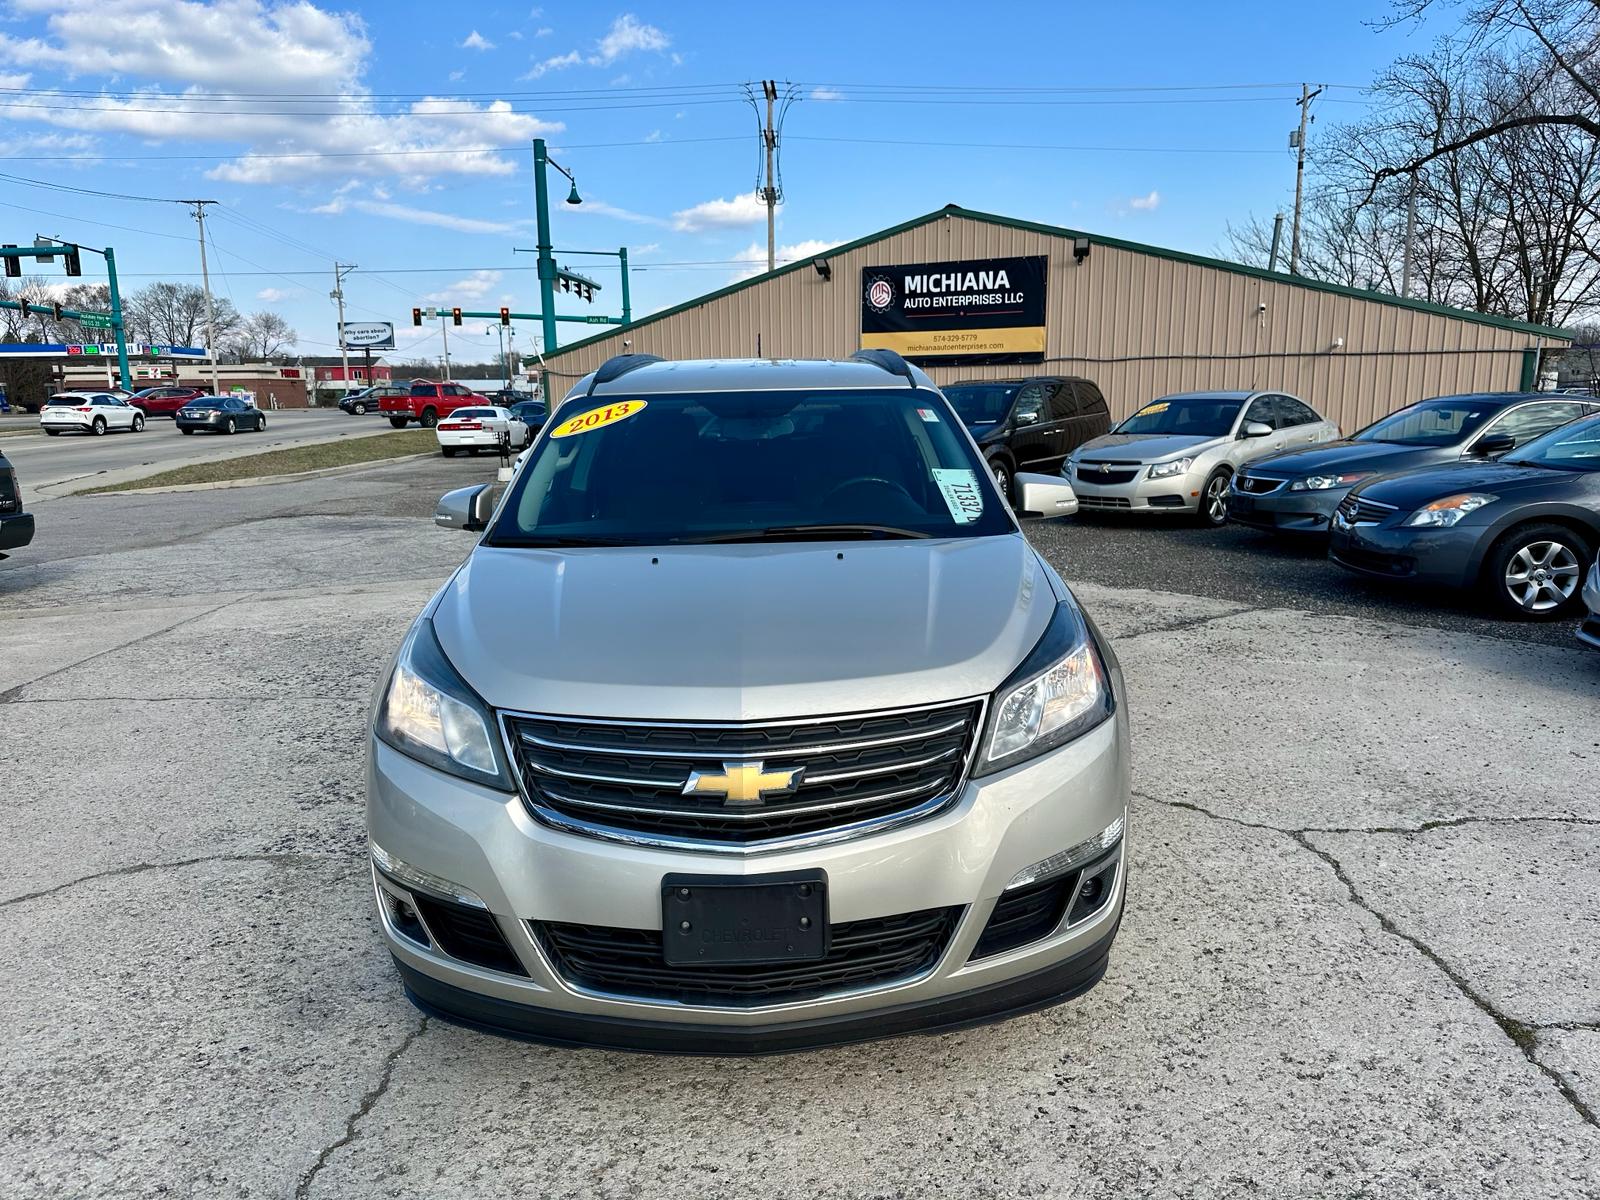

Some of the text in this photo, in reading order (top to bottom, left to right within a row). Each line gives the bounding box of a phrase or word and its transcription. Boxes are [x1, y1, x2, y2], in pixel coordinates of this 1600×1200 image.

[904, 270, 1010, 294] MICHIANA
[904, 292, 1024, 309] AUTO ENTERPRISES LLC
[907, 343, 1004, 351] michianaautoenterprises.com
[933, 334, 978, 343] 574-329-5779
[569, 403, 630, 433] 2013
[951, 483, 983, 513] 71332
[702, 927, 790, 944] CHEVROLET
